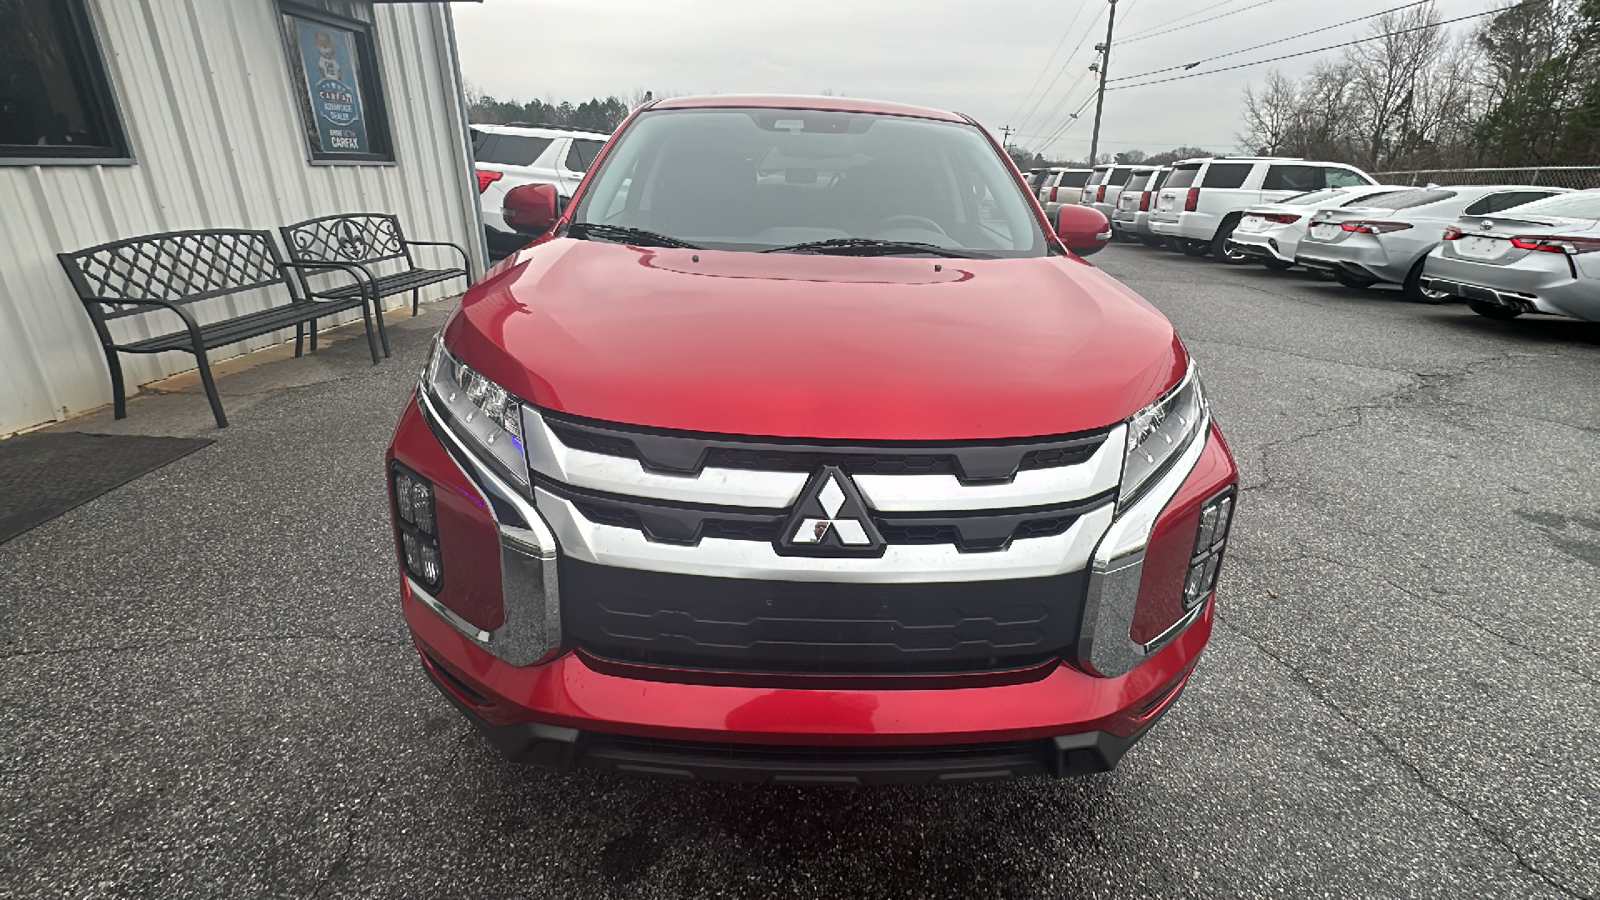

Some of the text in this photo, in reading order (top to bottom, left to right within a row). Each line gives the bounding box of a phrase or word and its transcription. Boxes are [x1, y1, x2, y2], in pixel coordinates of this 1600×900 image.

[320, 91, 353, 102] CARFAX
[324, 103, 353, 112] ADVANTAGE
[330, 112, 349, 120] DEALER
[331, 136, 359, 148] CARFAX
